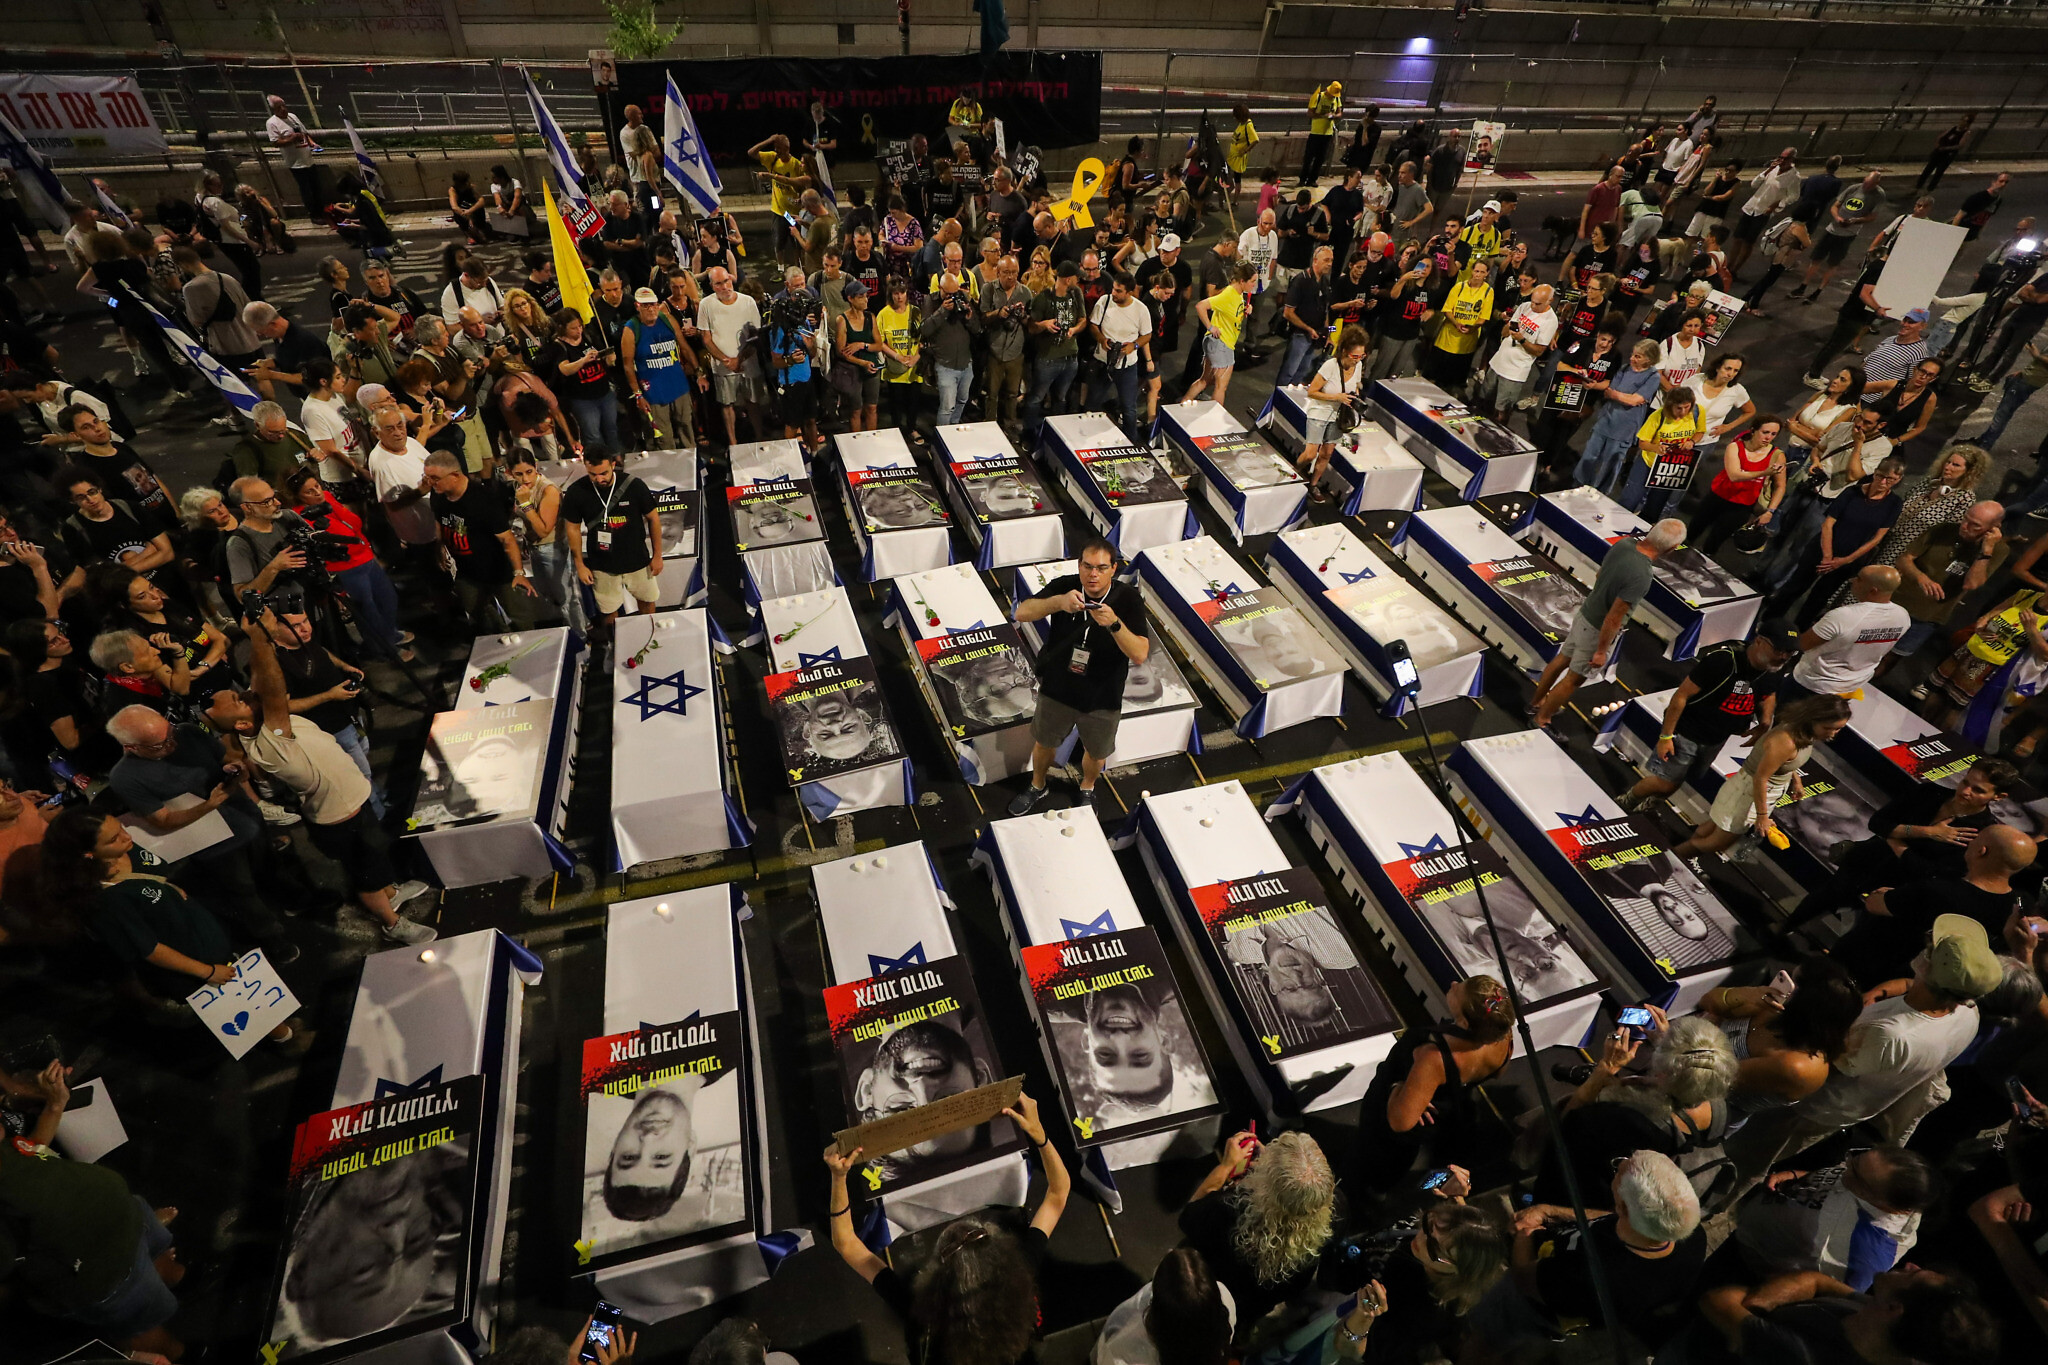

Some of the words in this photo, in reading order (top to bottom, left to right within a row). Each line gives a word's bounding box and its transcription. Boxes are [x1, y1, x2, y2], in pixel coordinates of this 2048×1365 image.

[926, 80, 984, 105] האה
[17, 92, 64, 129] זה
[56, 92, 108, 129] אם
[100, 91, 149, 128] מה
[1069, 201, 1083, 212] NOW.
[1656, 462, 1690, 477] העם
[742, 484, 771, 495] אברהם
[773, 481, 797, 492] מונדר
[937, 637, 958, 651] נדב
[958, 630, 997, 648] פופלוול
[937, 654, 966, 667] הופקר
[964, 649, 992, 661] למוות
[988, 643, 1011, 655] בשבי
[797, 669, 823, 684] חיים
[823, 666, 843, 678] פרי
[784, 692, 814, 705] הופקר
[815, 684, 842, 698] למוות
[840, 677, 865, 690] בשבי
[1571, 828, 1603, 846] אלכס
[1601, 822, 1639, 841] לובנוב
[1409, 859, 1447, 879] עמירם
[1445, 850, 1479, 872] קופ
[1586, 855, 1619, 871] הופקר
[1615, 849, 1644, 865] למוות
[1640, 843, 1662, 855] בשבי
[1226, 884, 1256, 904] יורם
[1255, 878, 1290, 898] מצגר
[1421, 886, 1452, 905] הופקר
[1224, 914, 1260, 934] הופקר
[1258, 906, 1290, 925] למוות
[1286, 899, 1316, 916] בשבי
[1060, 947, 1093, 967] אורי
[1092, 938, 1127, 961] דנינו
[853, 979, 900, 1008] אלמוג
[900, 969, 944, 997] סרוסי
[1053, 978, 1091, 1001] הופקר
[1090, 969, 1124, 992] למוות
[1122, 964, 1154, 980] בשבי
[852, 1018, 891, 1043] הופקר
[893, 1006, 929, 1030] למוות
[926, 996, 961, 1017] בשבי
[609, 1041, 646, 1063] איתי
[650, 1021, 717, 1055] סבירסקי
[603, 1073, 645, 1098] הופקר
[647, 1064, 686, 1089] למוות
[687, 1055, 723, 1075] בשבי
[328, 1108, 374, 1141] אריה
[320, 1151, 368, 1182] הופקר
[371, 1136, 415, 1166] למוות
[418, 1126, 456, 1151] בשבי
